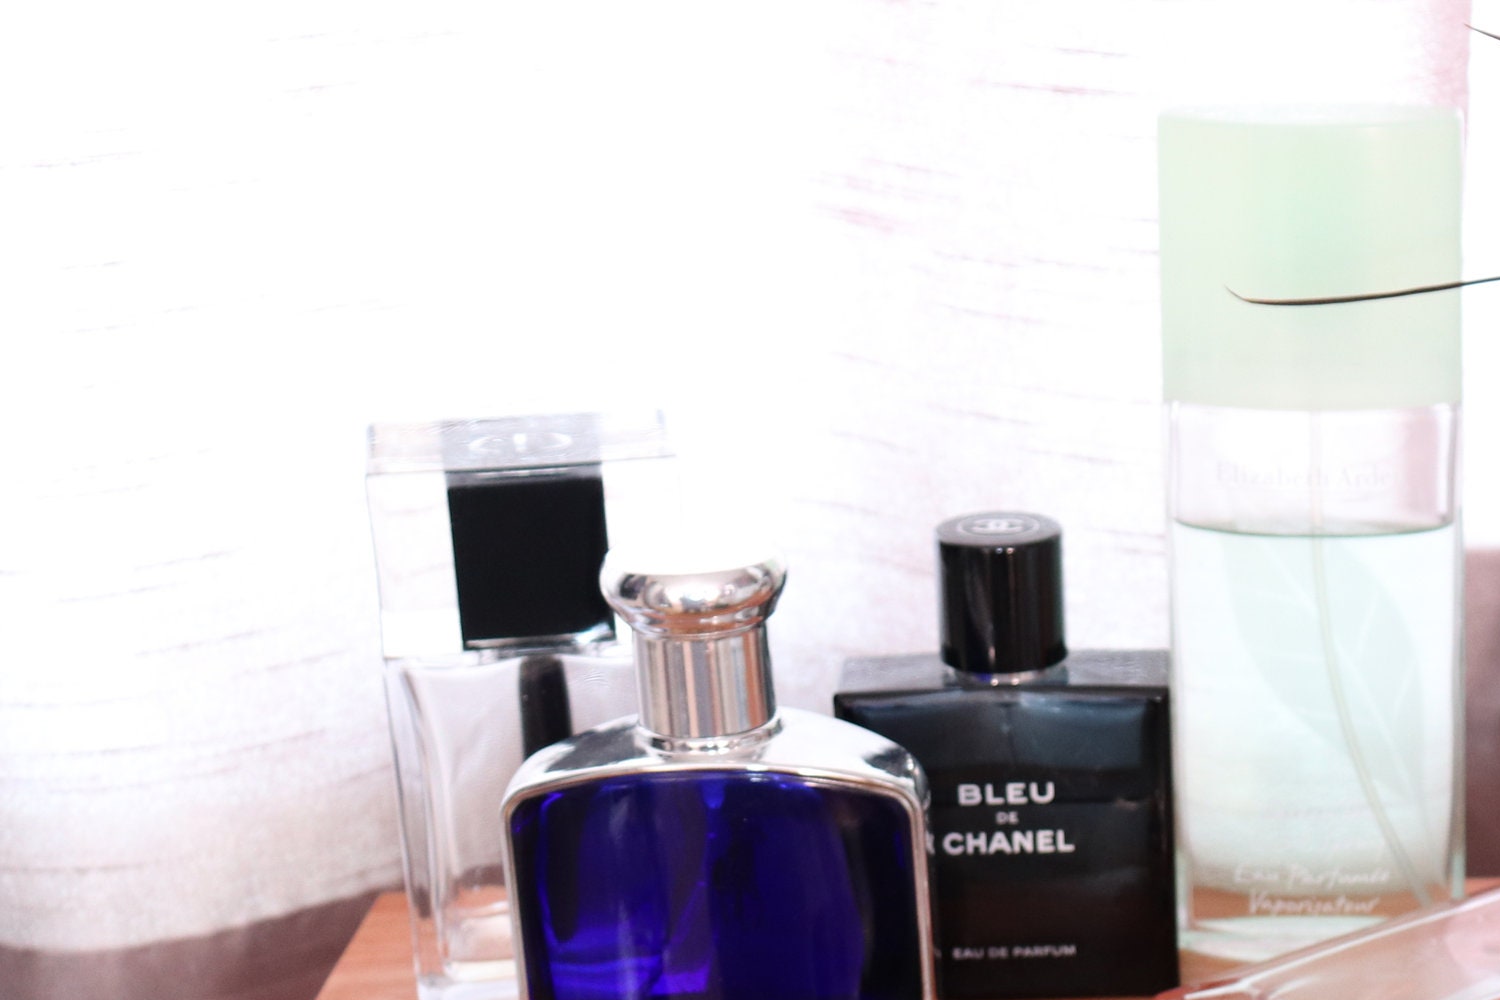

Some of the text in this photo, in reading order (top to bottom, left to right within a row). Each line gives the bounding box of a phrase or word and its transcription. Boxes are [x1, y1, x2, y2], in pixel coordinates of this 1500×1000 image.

[957, 781, 1055, 806] BLEU
[995, 811, 1019, 825] DE
[942, 829, 1076, 855] CHANEL
[952, 944, 1077, 960] EAU DE PARFUM
